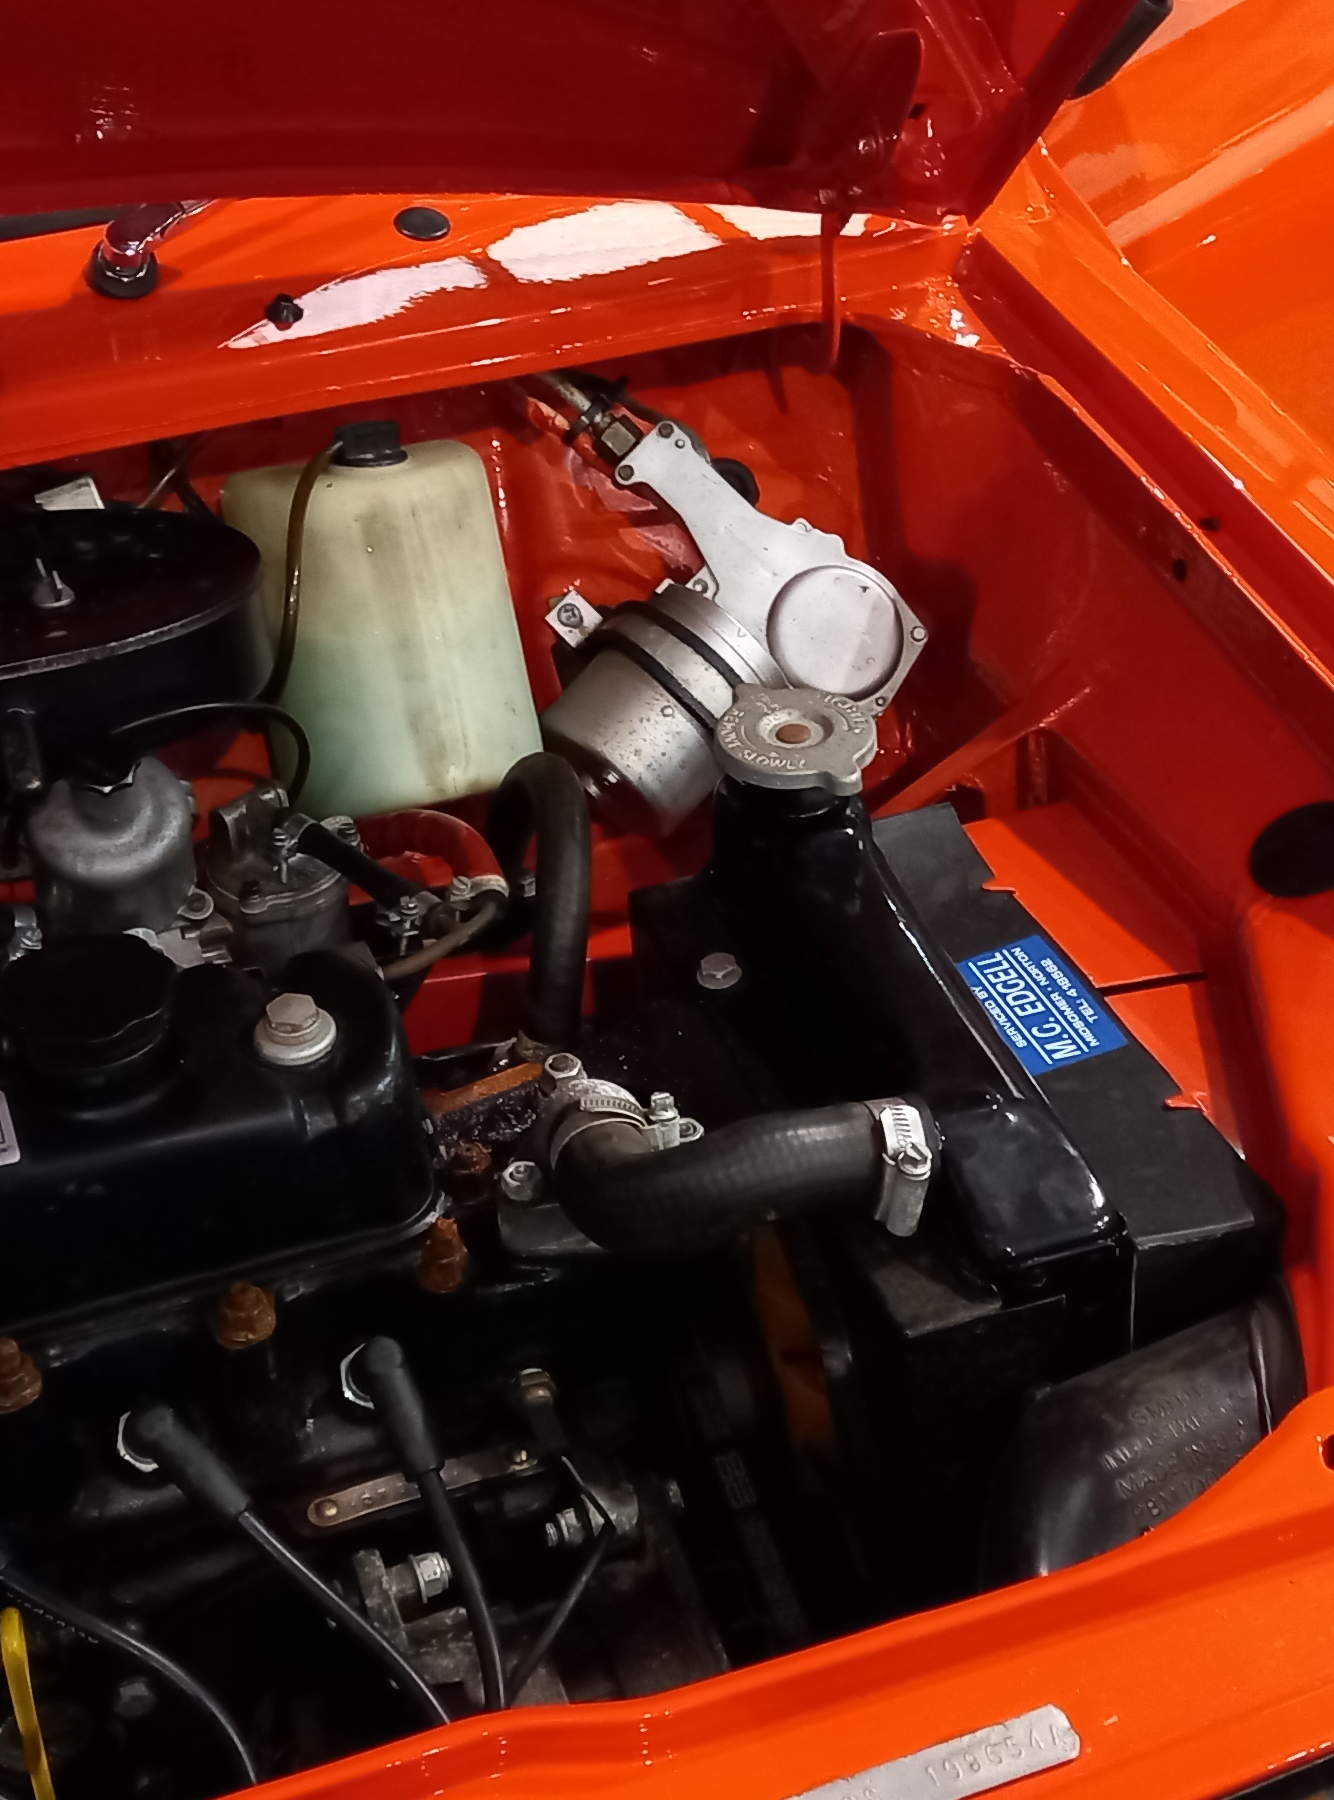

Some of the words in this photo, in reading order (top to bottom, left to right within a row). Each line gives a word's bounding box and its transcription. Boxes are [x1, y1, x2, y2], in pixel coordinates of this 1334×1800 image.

[1010, 947, 1050, 987] NORTON
[1040, 957, 1079, 998] 418562
[970, 986, 989, 1000] BY
[984, 1000, 1028, 1048] SERVICED
[1049, 992, 1101, 1047] MIDSOMER
